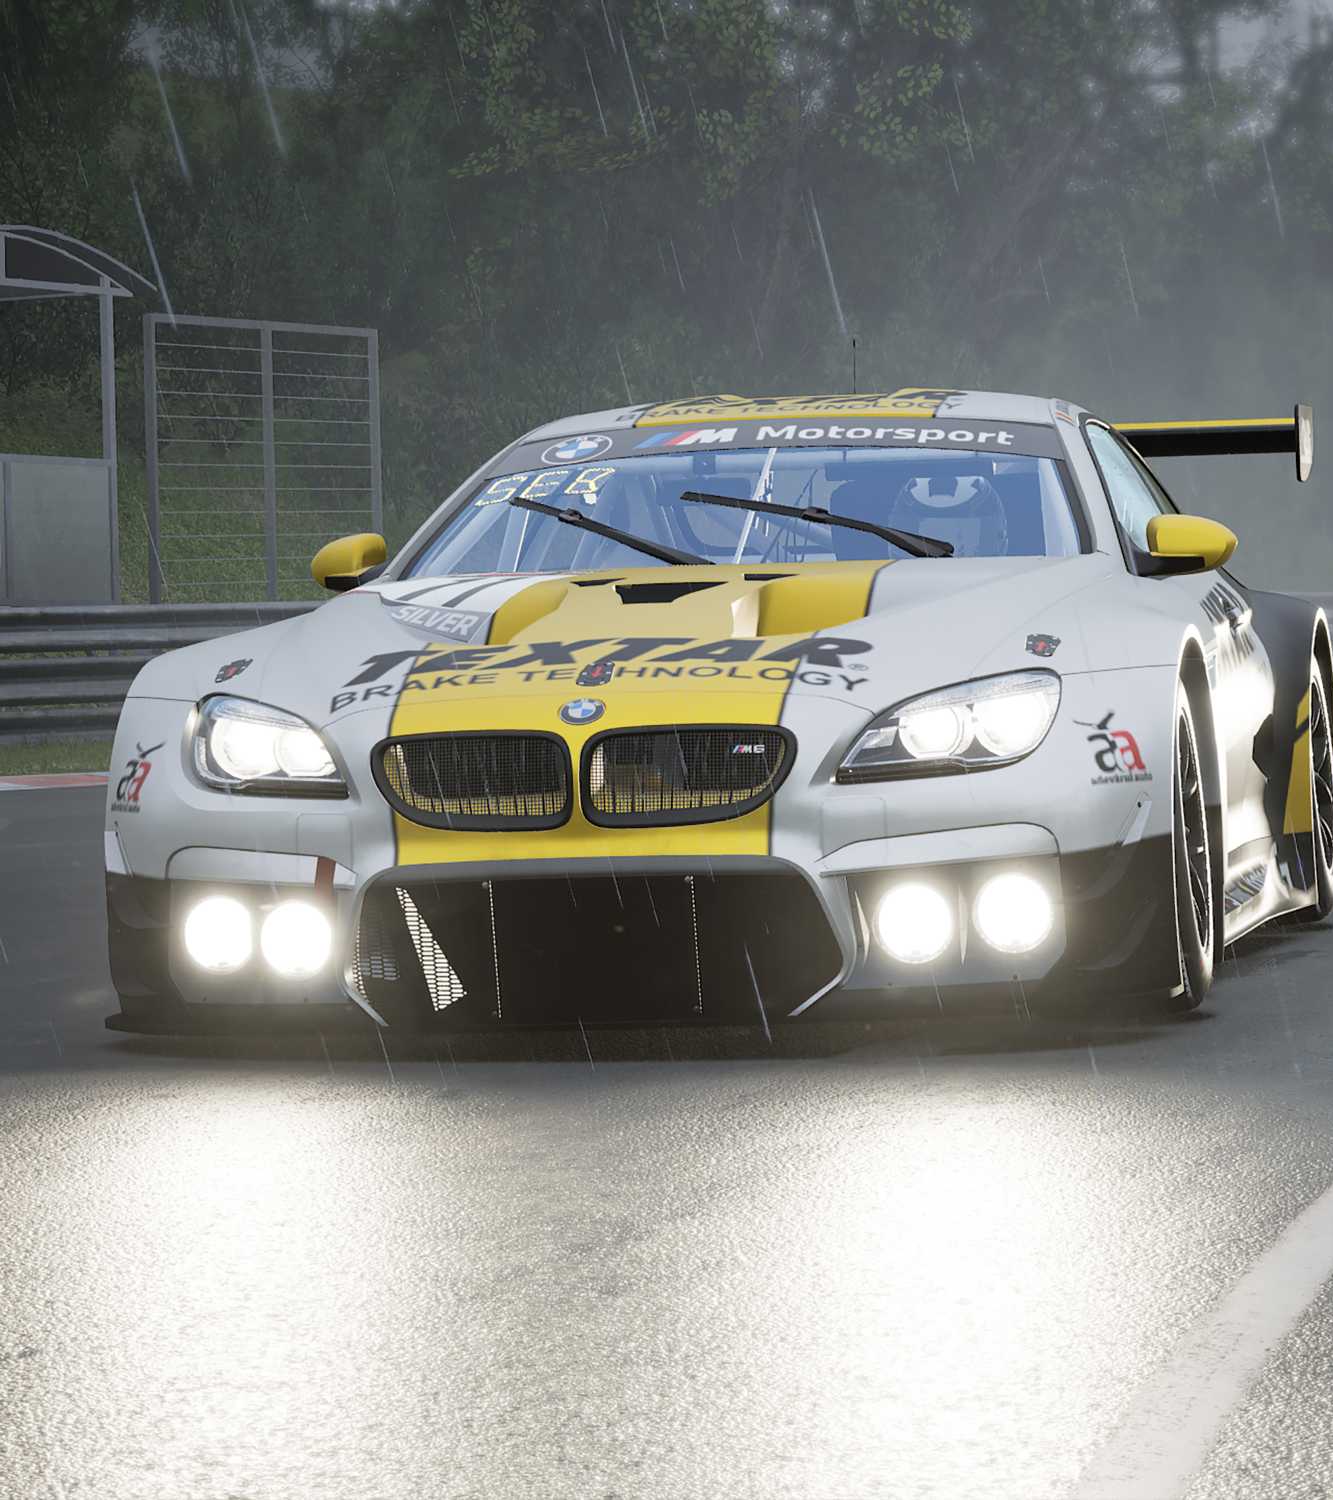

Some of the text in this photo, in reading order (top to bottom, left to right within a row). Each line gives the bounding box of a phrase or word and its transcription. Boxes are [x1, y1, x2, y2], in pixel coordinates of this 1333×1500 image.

[755, 424, 1014, 448] Motorsport
[391, 606, 480, 636] SILVER
[341, 637, 874, 688] TEXTAR
[330, 666, 869, 713] BRAKE TEHNOLOGY
